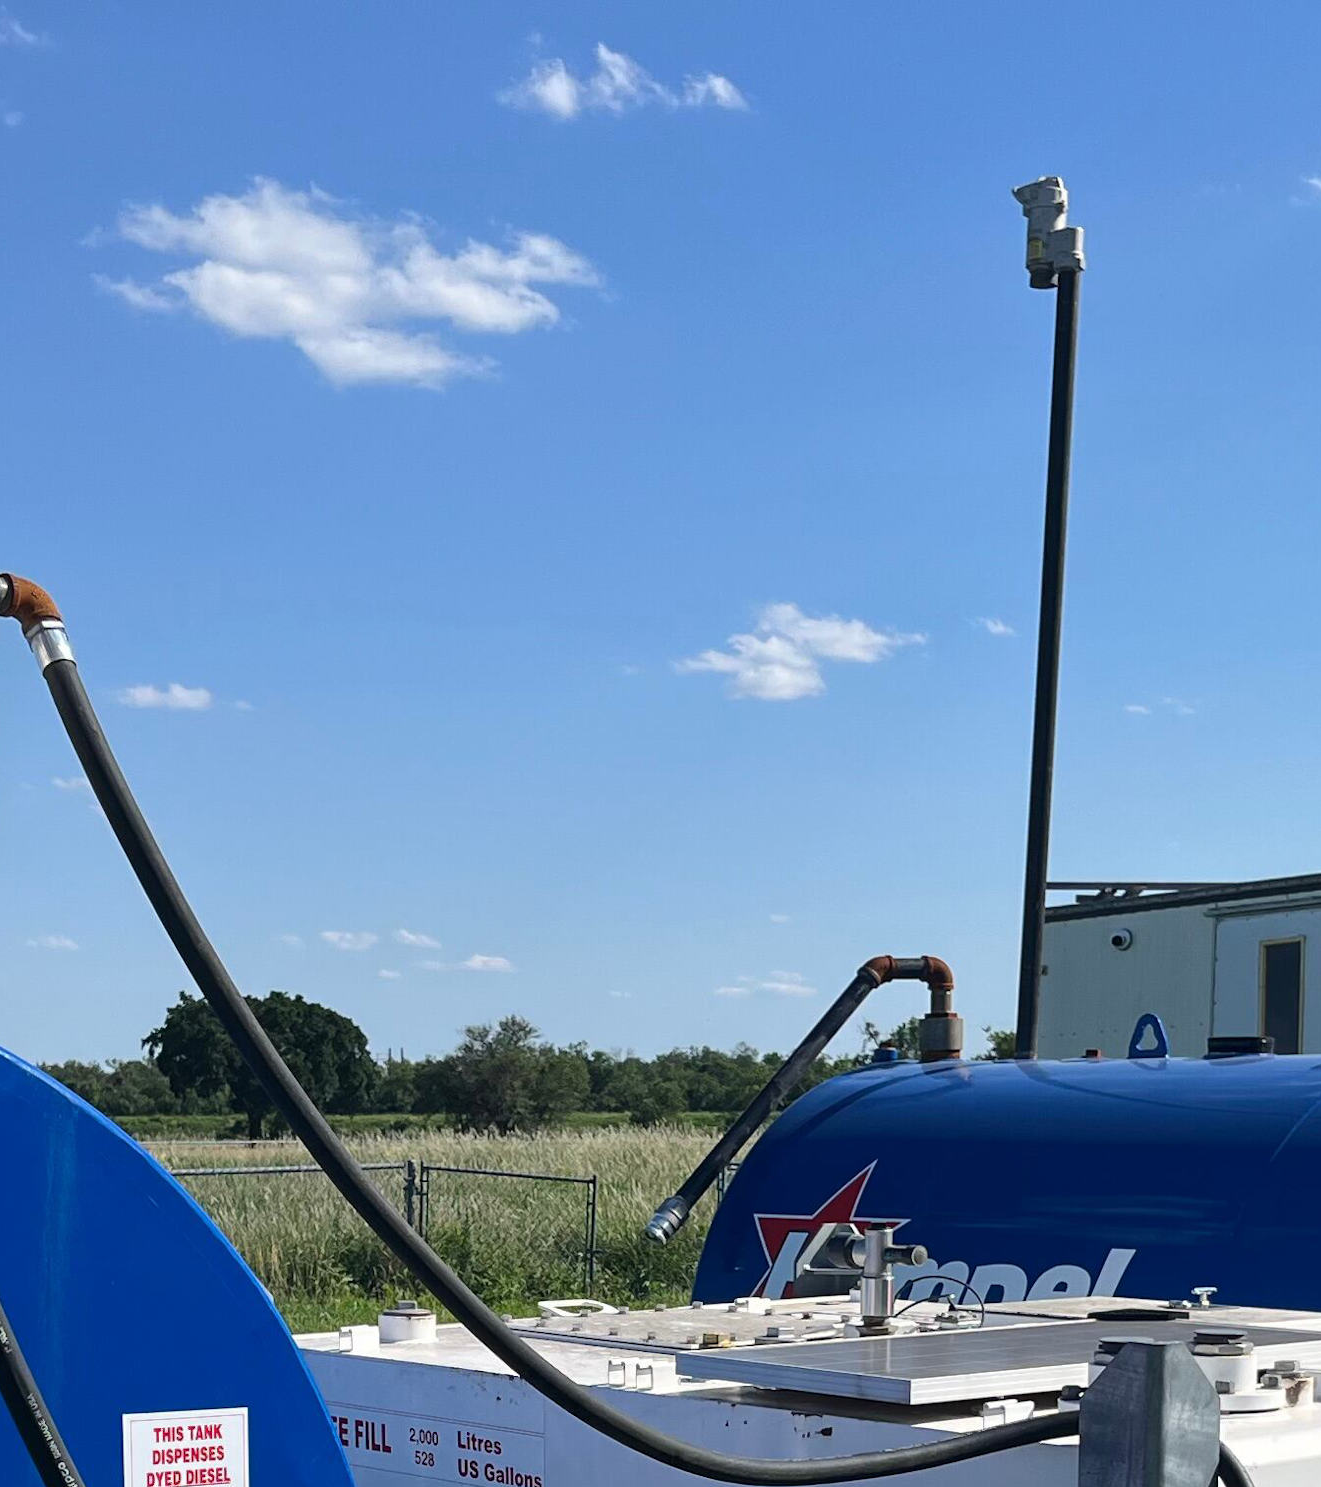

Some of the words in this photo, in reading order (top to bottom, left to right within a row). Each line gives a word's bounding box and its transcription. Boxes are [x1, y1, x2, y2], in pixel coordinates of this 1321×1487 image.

[153, 1426, 184, 1443] THIS
[187, 1423, 223, 1441] TANK
[355, 1420, 392, 1454] FILL
[409, 1428, 439, 1446] 2,000
[457, 1431, 502, 1455] Litres
[152, 1445, 225, 1465] DISPENSES
[414, 1450, 436, 1467] 528
[457, 1458, 479, 1479] US
[146, 1470, 181, 1487] DYED
[186, 1467, 231, 1485] DIESEL
